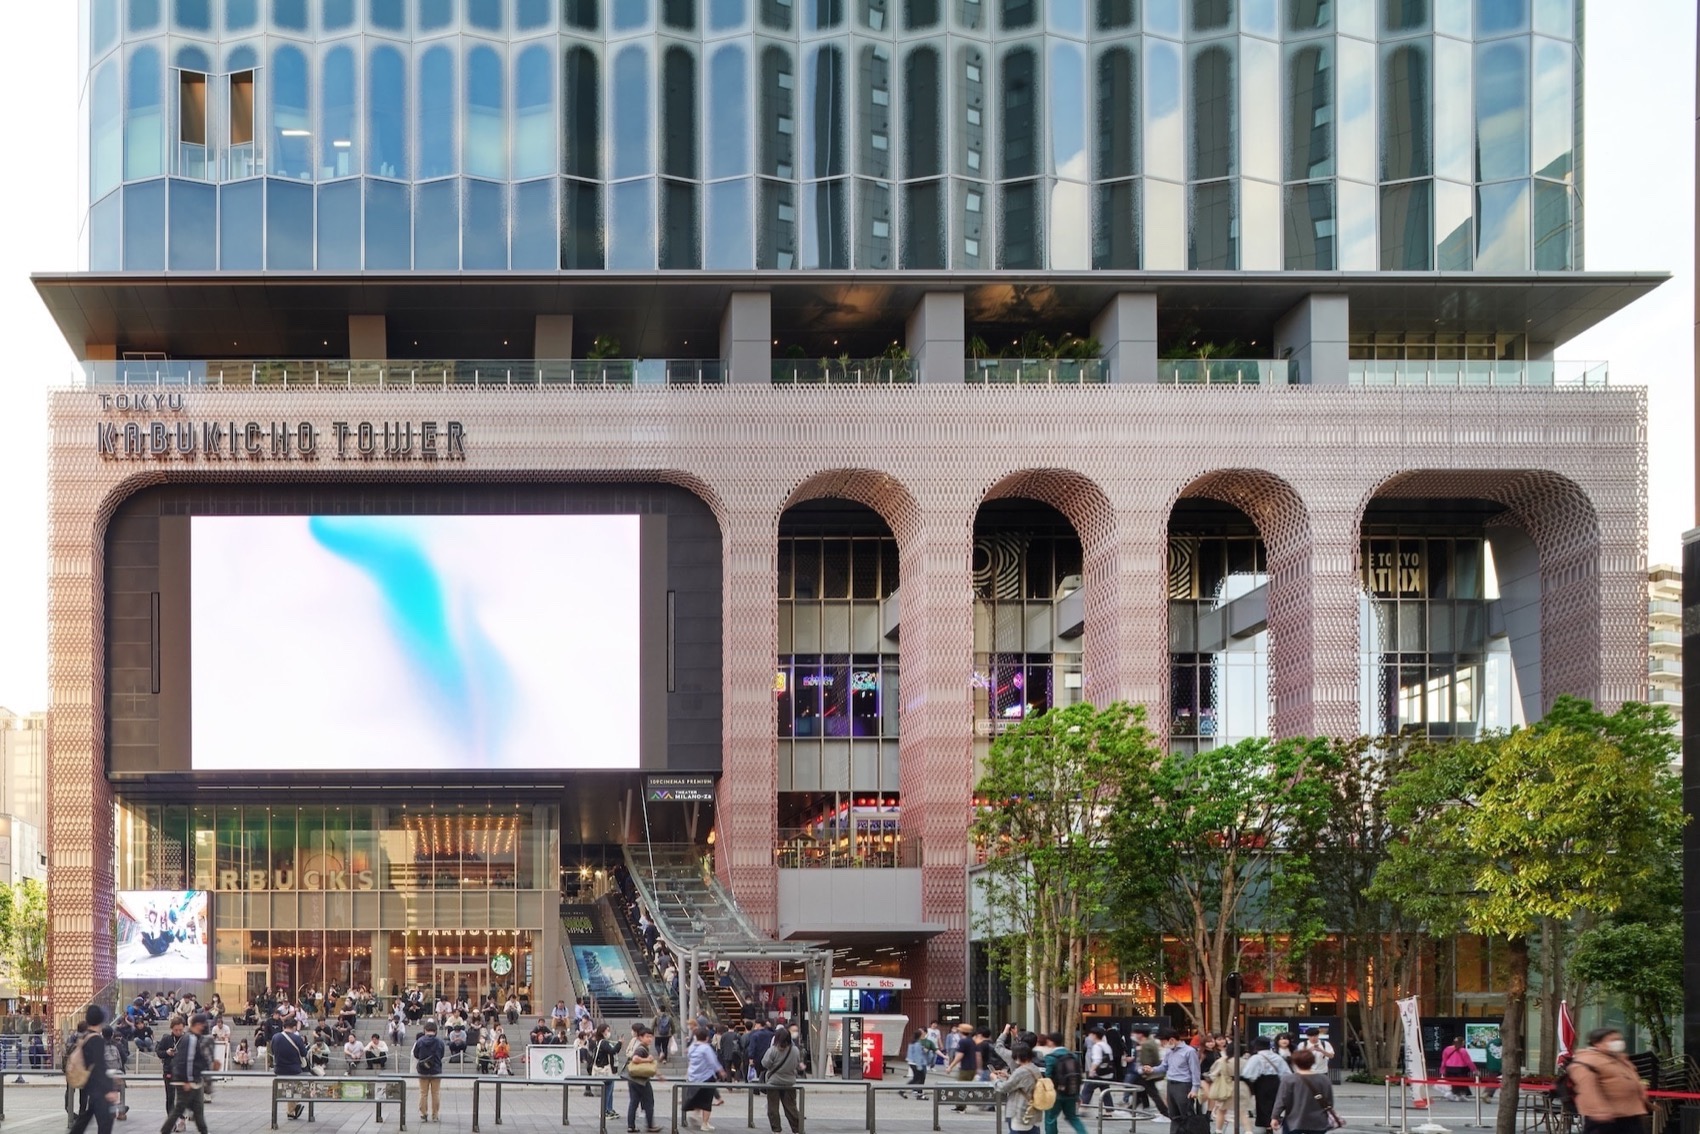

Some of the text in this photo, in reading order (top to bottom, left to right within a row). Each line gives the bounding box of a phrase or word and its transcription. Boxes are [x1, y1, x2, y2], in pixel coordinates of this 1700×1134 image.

[99, 393, 184, 411] TOKYU
[97, 421, 467, 456] KABUKICHO TOWER
[1360, 568, 1420, 592] ATIX
[843, 979, 894, 987] tkts tkts
